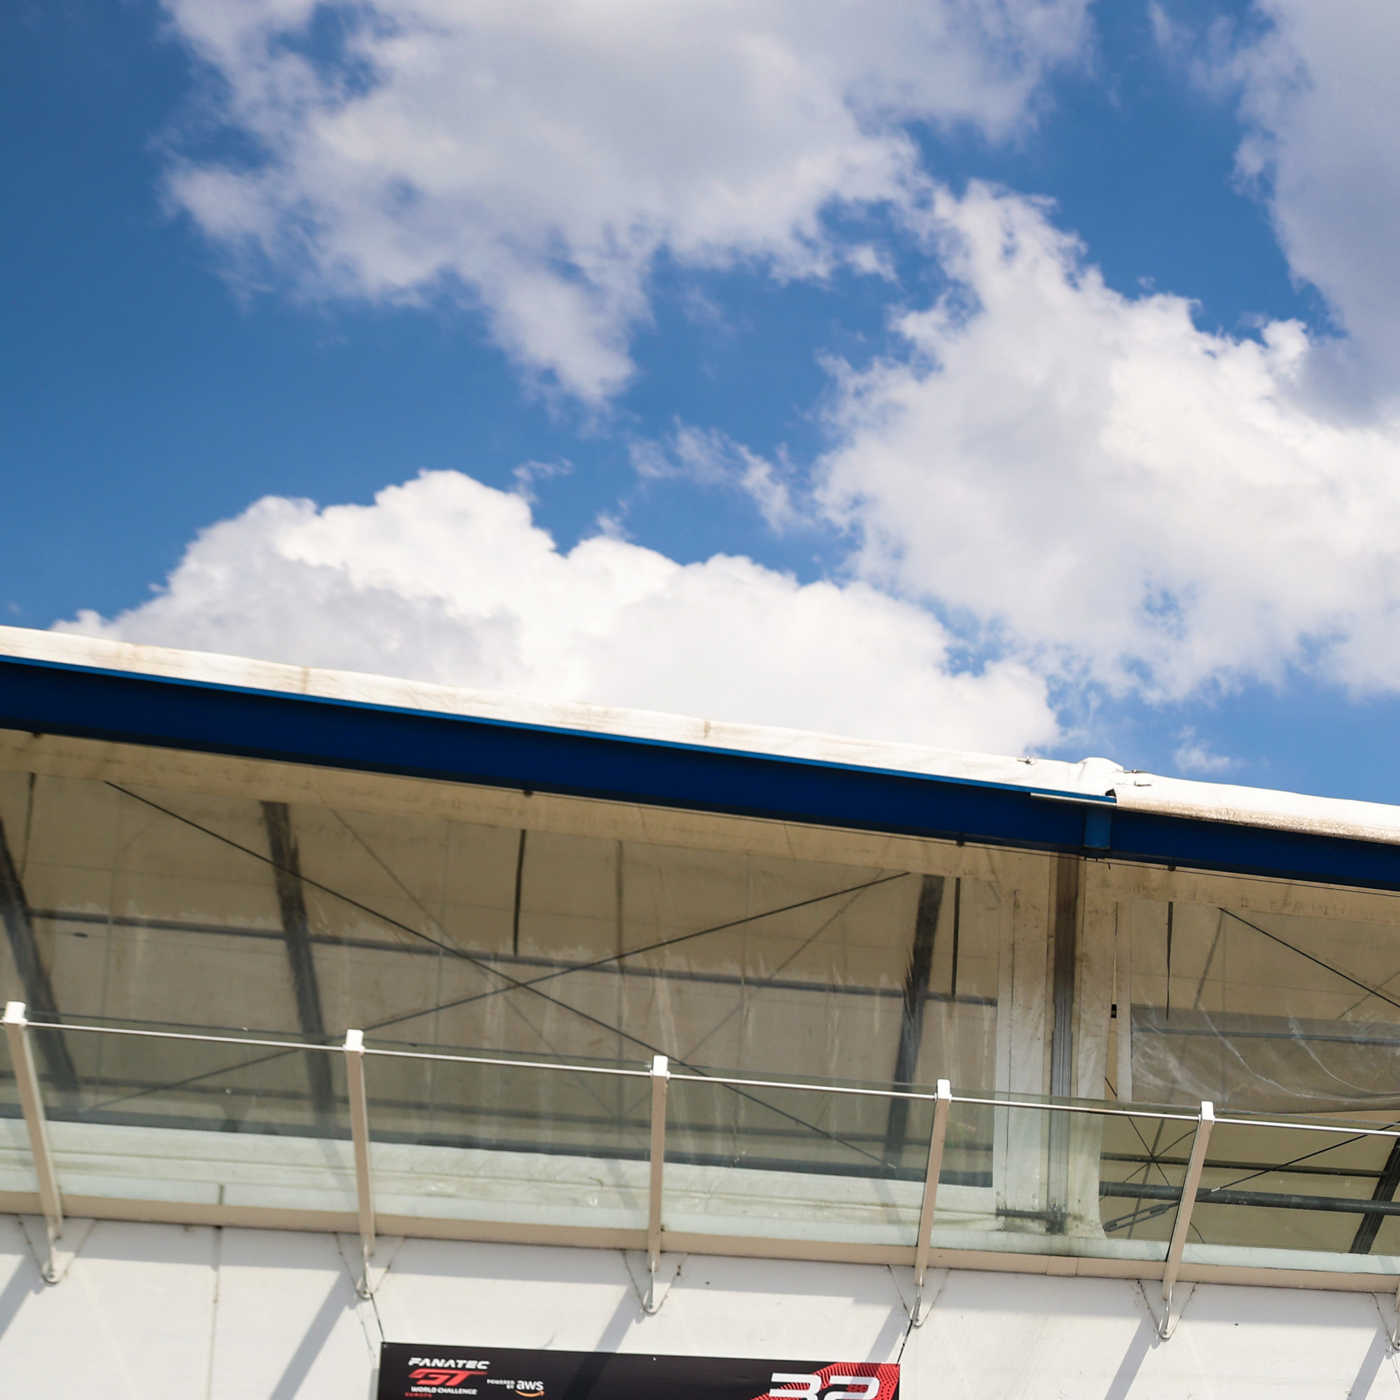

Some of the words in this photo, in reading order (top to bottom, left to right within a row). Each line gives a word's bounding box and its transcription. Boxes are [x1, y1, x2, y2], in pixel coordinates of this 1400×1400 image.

[408, 1357, 490, 1369] FANATEC
[411, 1386, 437, 1394] WORLD
[437, 1387, 478, 1396] CHALLENGE
[516, 1380, 545, 1392] aws
